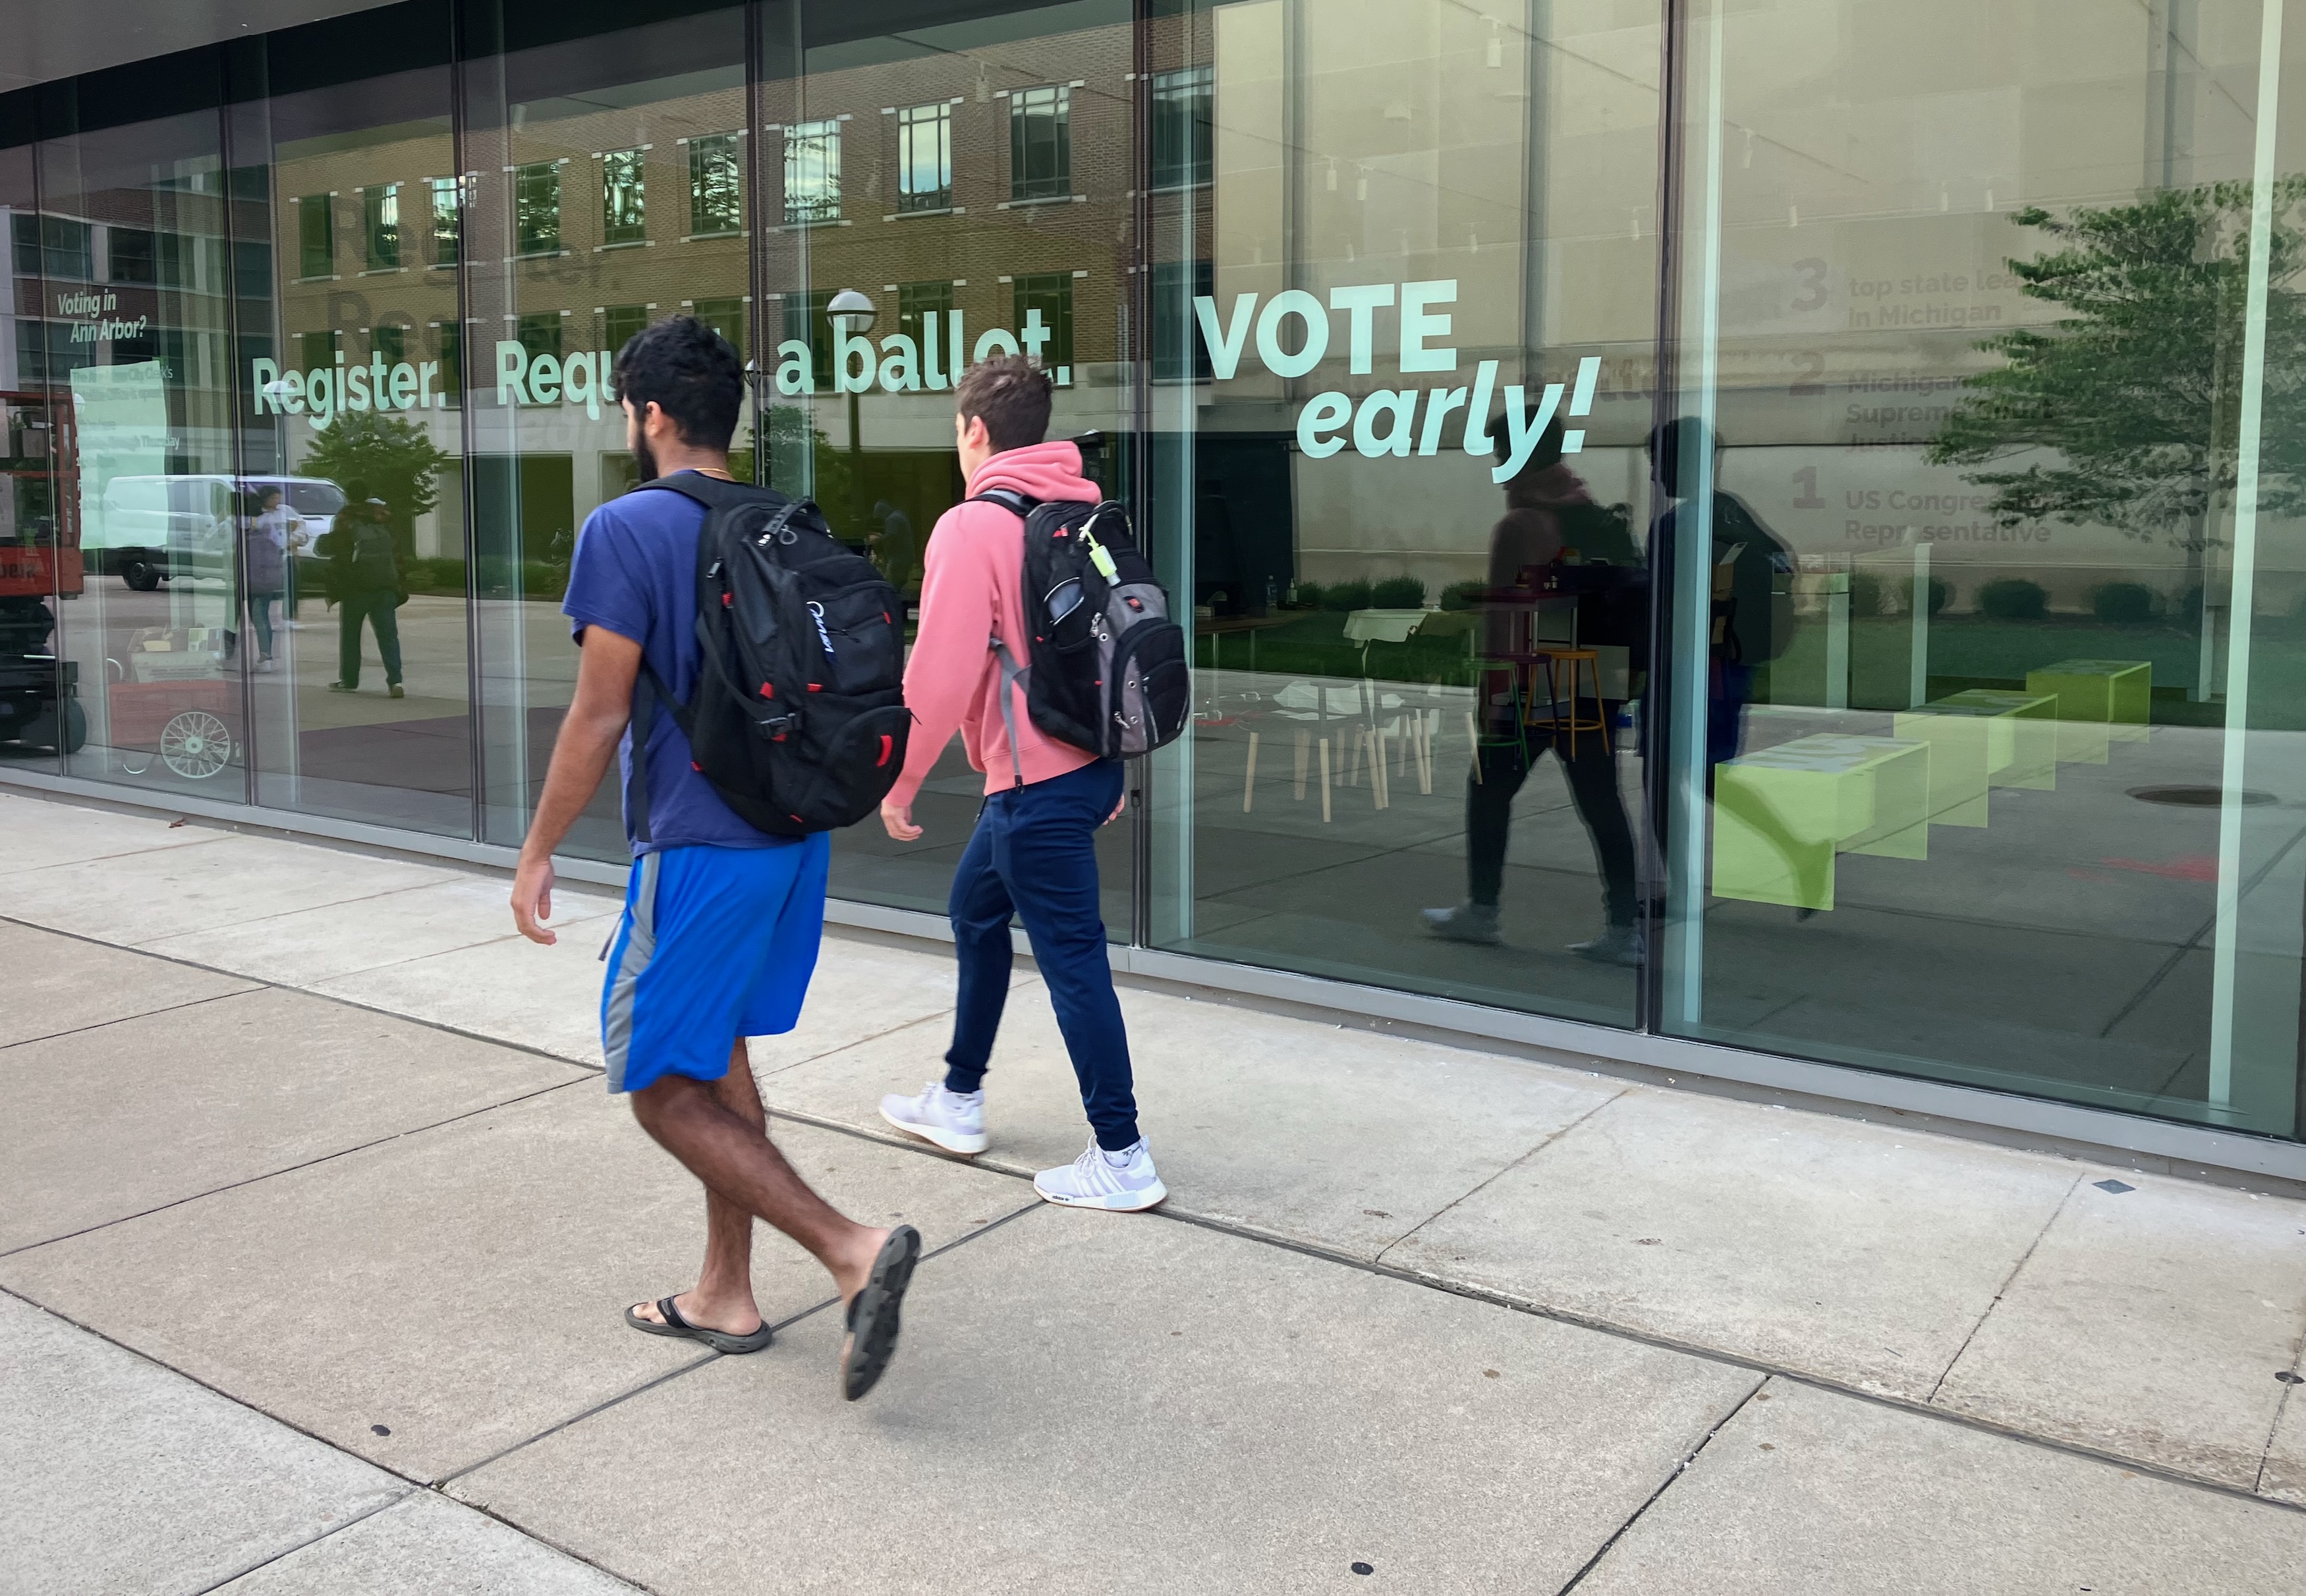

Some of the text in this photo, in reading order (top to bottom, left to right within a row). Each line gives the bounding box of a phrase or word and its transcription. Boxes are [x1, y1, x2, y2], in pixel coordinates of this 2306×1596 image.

[1791, 258, 1828, 312] 3
[1850, 277, 1892, 301] top
[1900, 272, 1969, 294] state
[58, 289, 117, 319] Voting in
[1848, 306, 1871, 327] in
[1878, 303, 2002, 327] Michigan
[70, 314, 147, 343] Ann Arbor?
[1193, 279, 1458, 380] VOTE
[777, 339, 815, 397] a
[1789, 351, 1826, 397] 2
[252, 350, 447, 430] Register.
[1296, 356, 1602, 485] early!
[1846, 402, 1967, 428] Supreme
[1791, 465, 1826, 509] 1
[1845, 489, 1881, 510] US
[1845, 519, 2052, 545] Reprsentative
